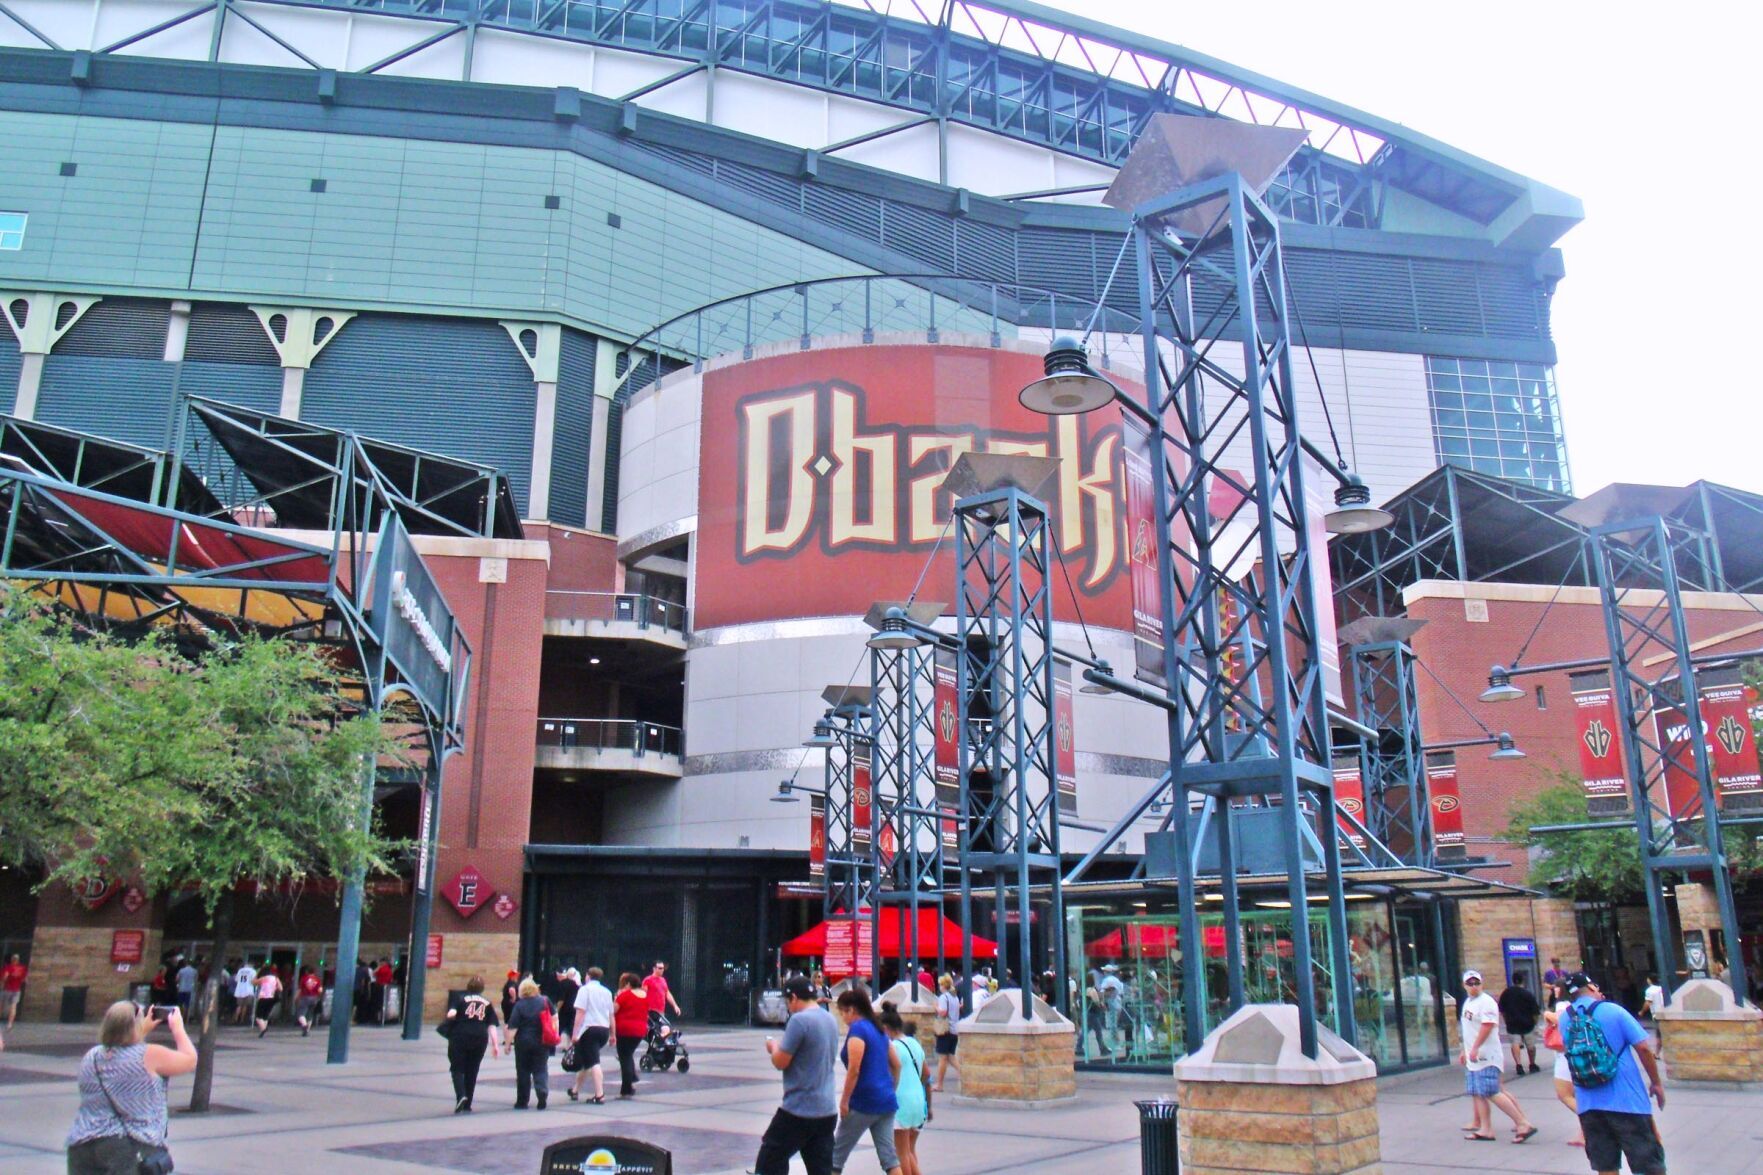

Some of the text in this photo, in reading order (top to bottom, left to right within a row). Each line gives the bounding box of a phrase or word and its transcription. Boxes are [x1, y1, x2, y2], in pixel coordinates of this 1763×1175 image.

[740, 387, 1131, 590] Dbak
[458, 881, 477, 907] E
[464, 1001, 486, 1021] 44
[621, 1165, 654, 1173] APPETIT
